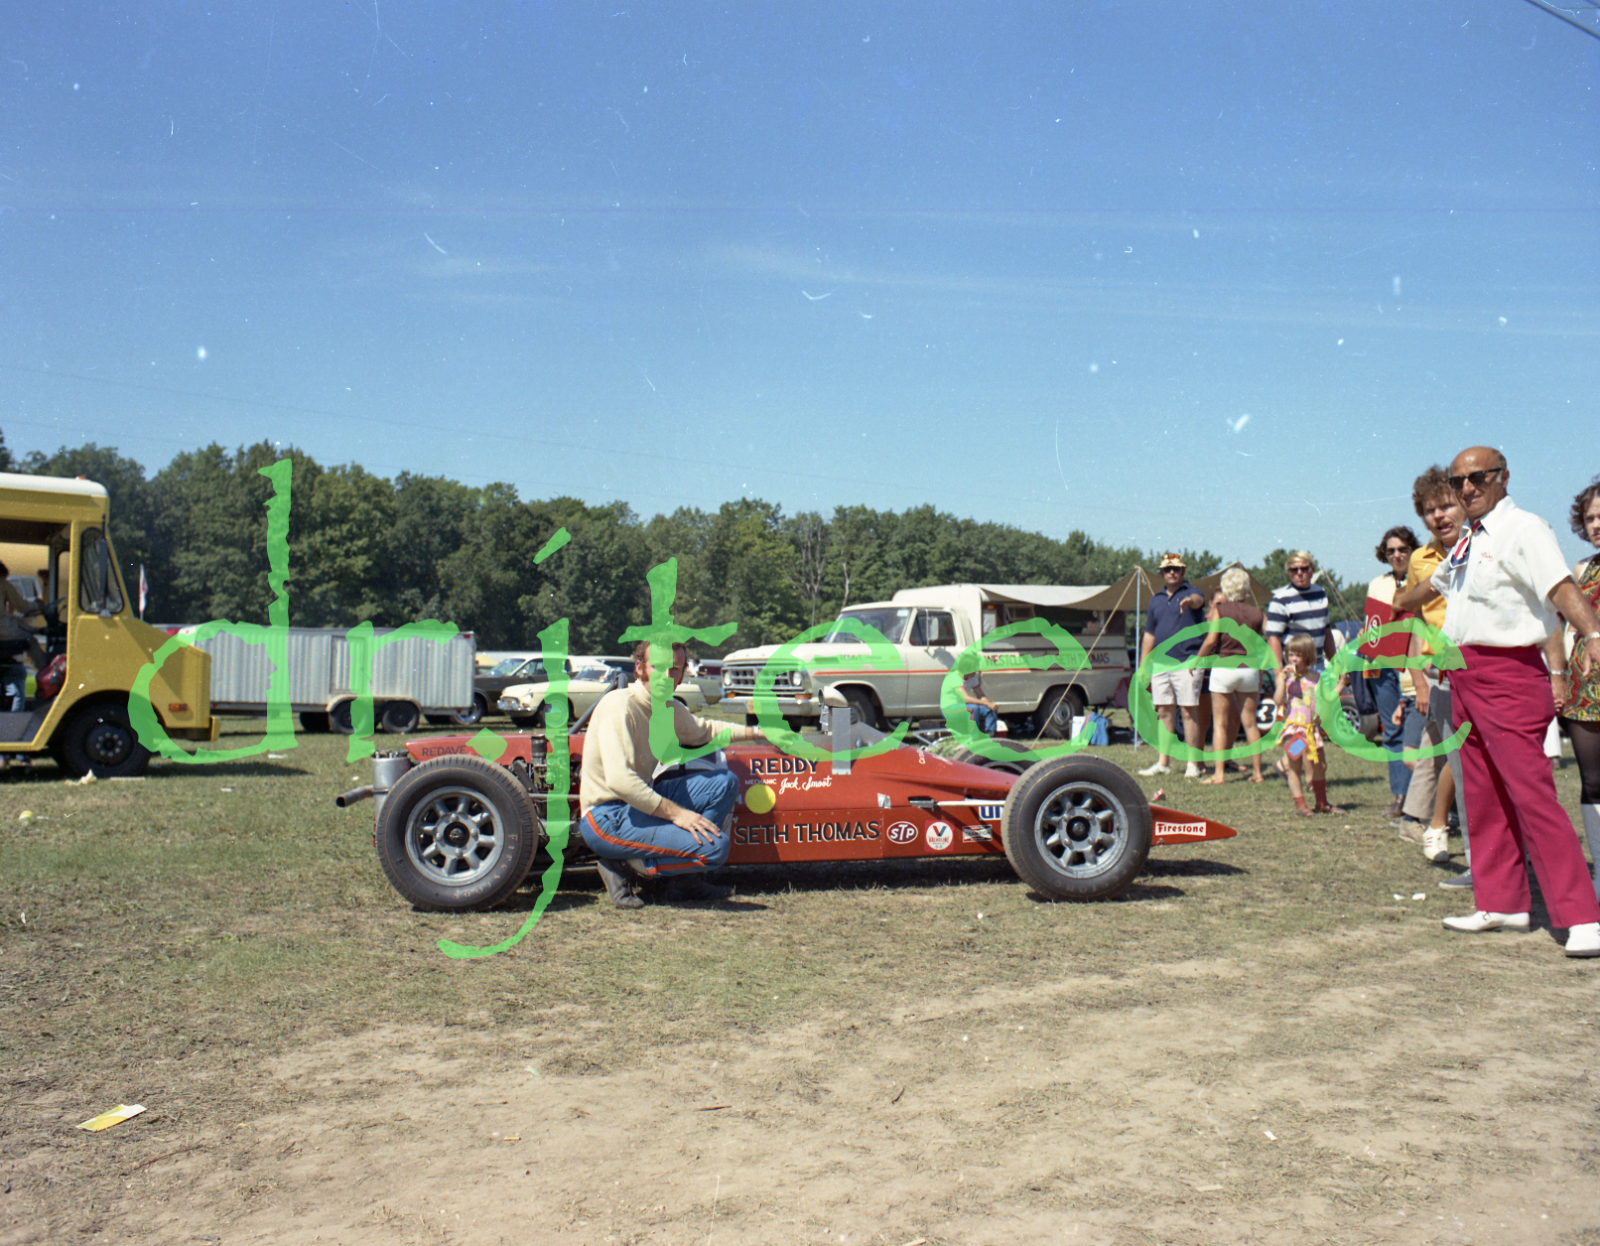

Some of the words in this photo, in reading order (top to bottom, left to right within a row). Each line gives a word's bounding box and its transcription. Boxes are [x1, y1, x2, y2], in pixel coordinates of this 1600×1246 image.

[1055, 653, 1077, 665] SETH
[421, 746, 467, 757] REDAVE
[749, 757, 819, 775] REDDY
[779, 776, 801, 794] Jack
[734, 823, 789, 845] SETH
[793, 820, 880, 843] THOMAS
[890, 823, 916, 841] STP
[1156, 823, 1205, 834] Firestone
